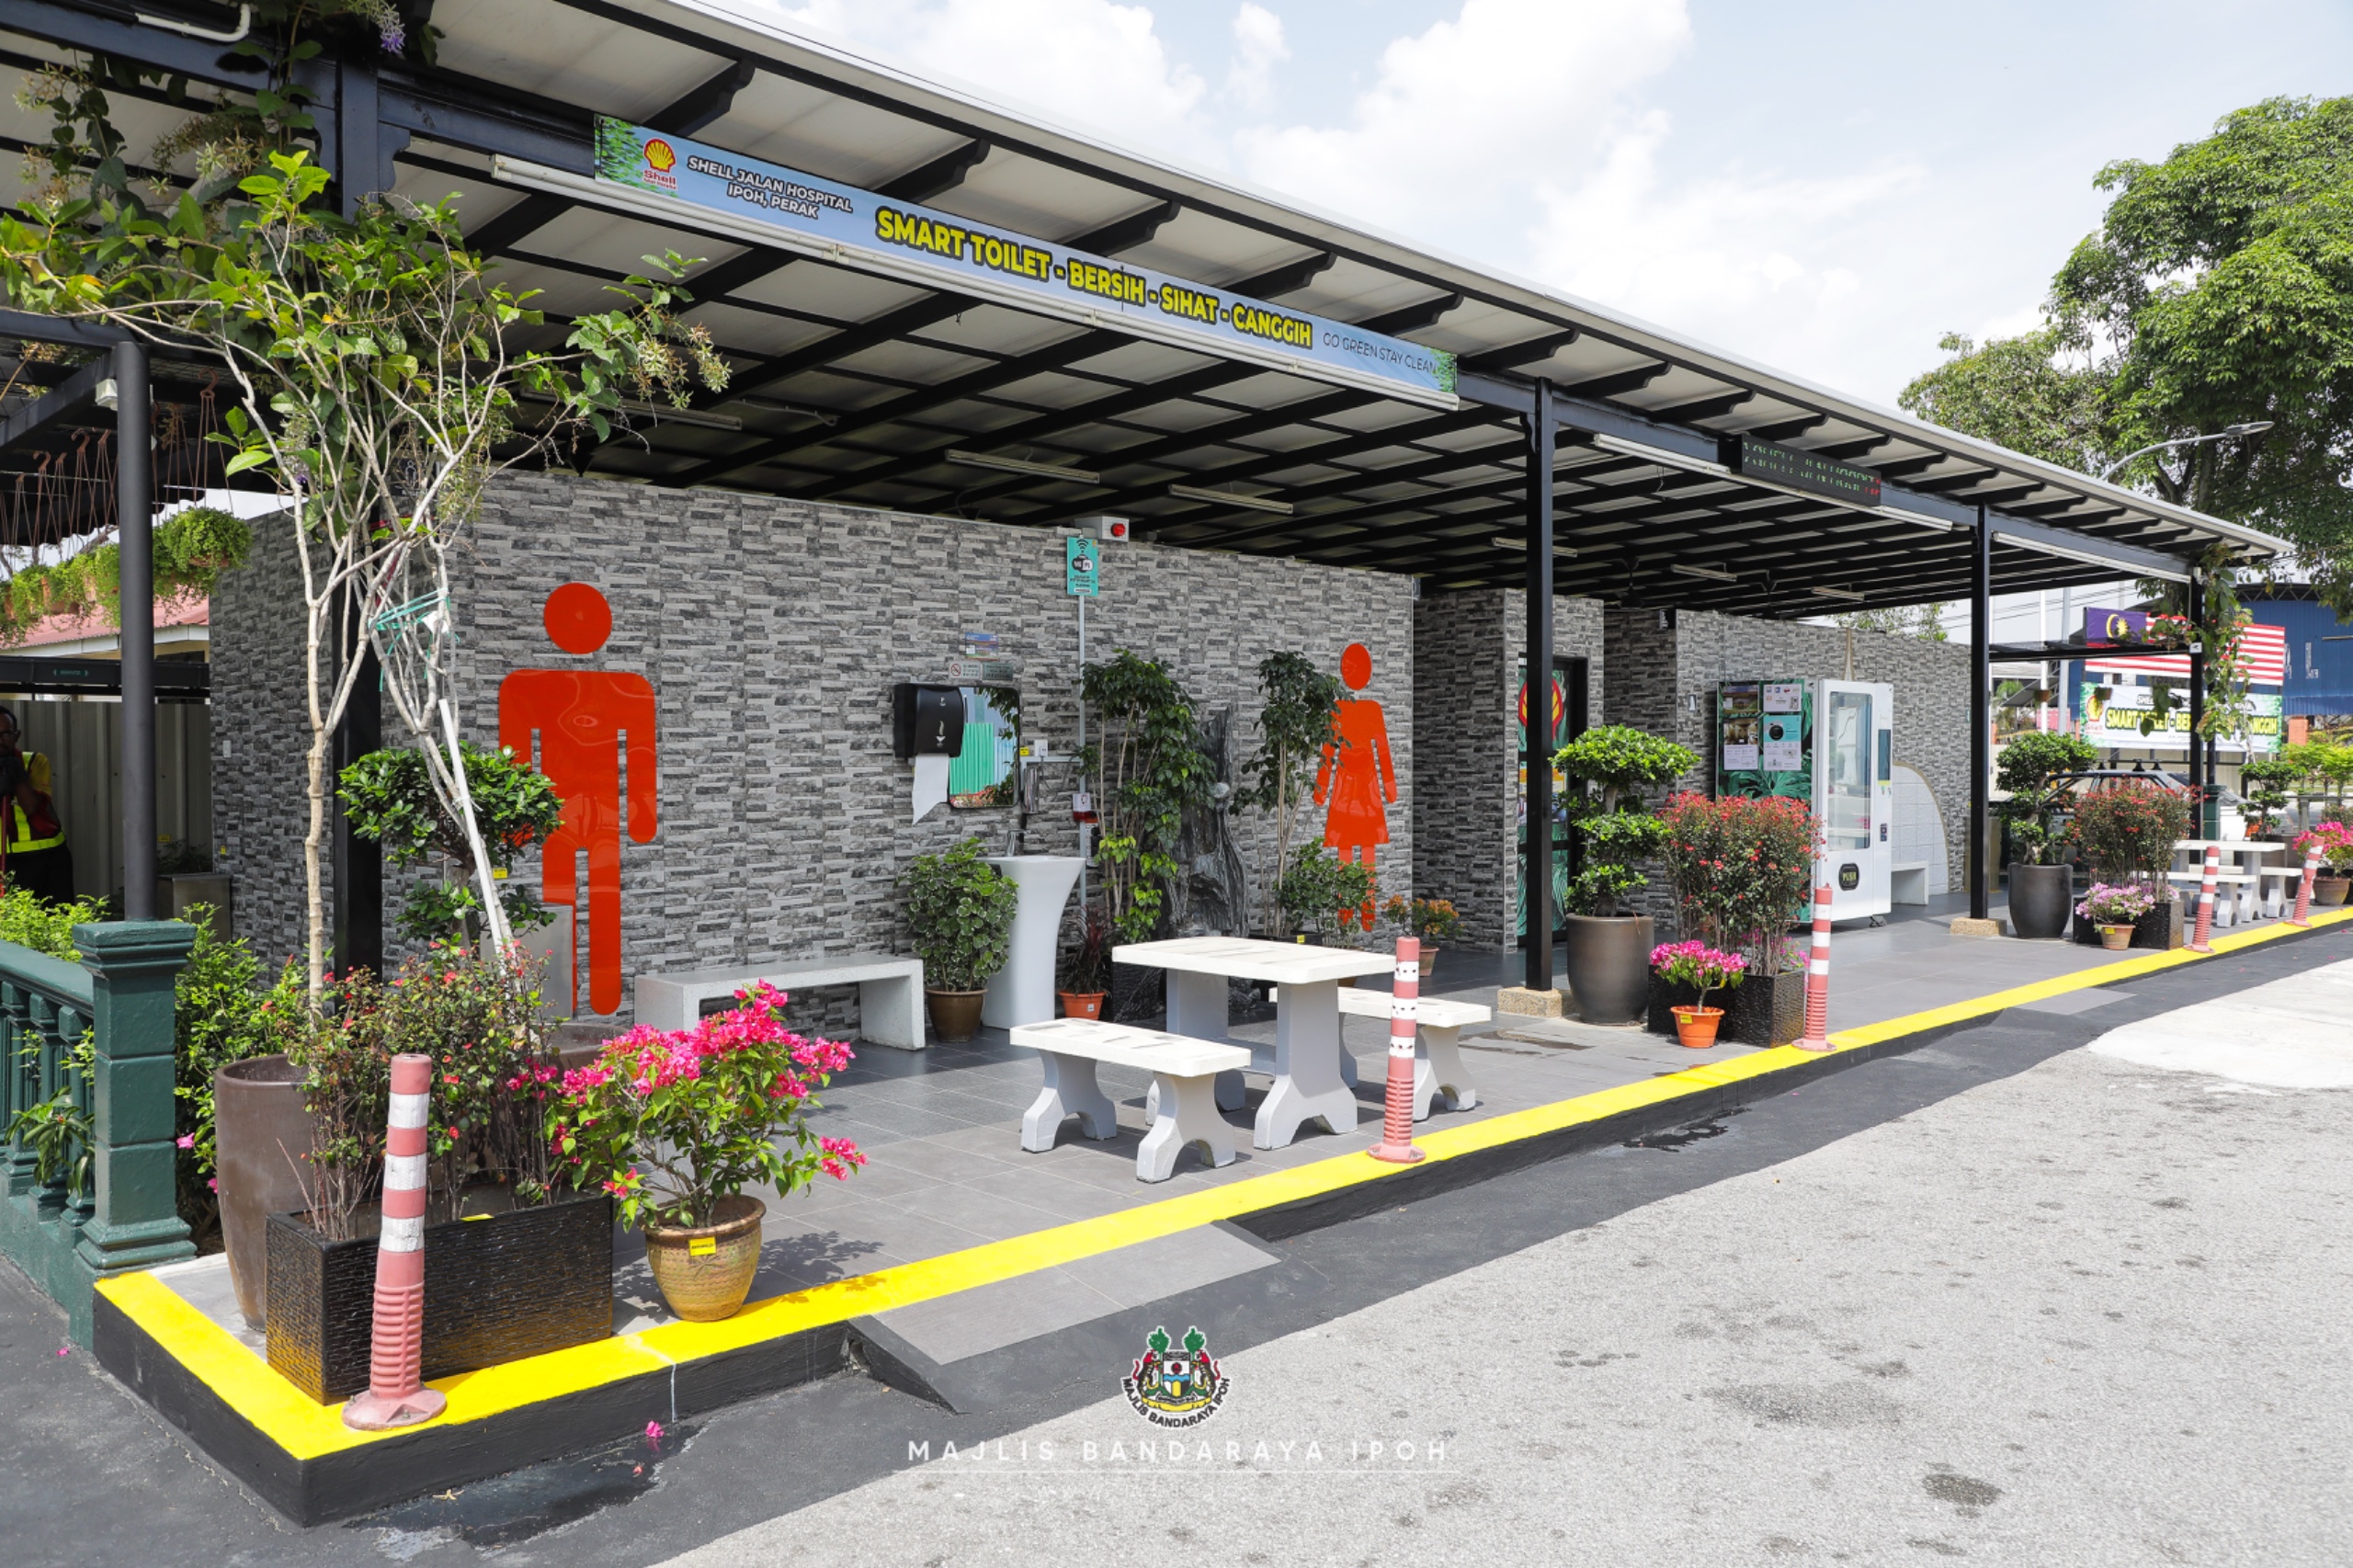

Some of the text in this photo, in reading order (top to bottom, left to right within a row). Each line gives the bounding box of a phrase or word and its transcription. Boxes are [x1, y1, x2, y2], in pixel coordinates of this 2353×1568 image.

[643, 169, 676, 186] Shell
[688, 156, 853, 212] SHELL JALAN HOSPITAL
[727, 182, 819, 220] IPOH, PERAK
[876, 207, 965, 259] SMART
[968, 232, 1051, 281] TOILET
[1067, 258, 1145, 305] BERSIH
[1160, 283, 1220, 322] SIHAT
[1232, 302, 1313, 348] CANGGIH
[1324, 333, 1437, 373] GO GREEN STAY CLEAN
[2105, 708, 2138, 730] SMART
